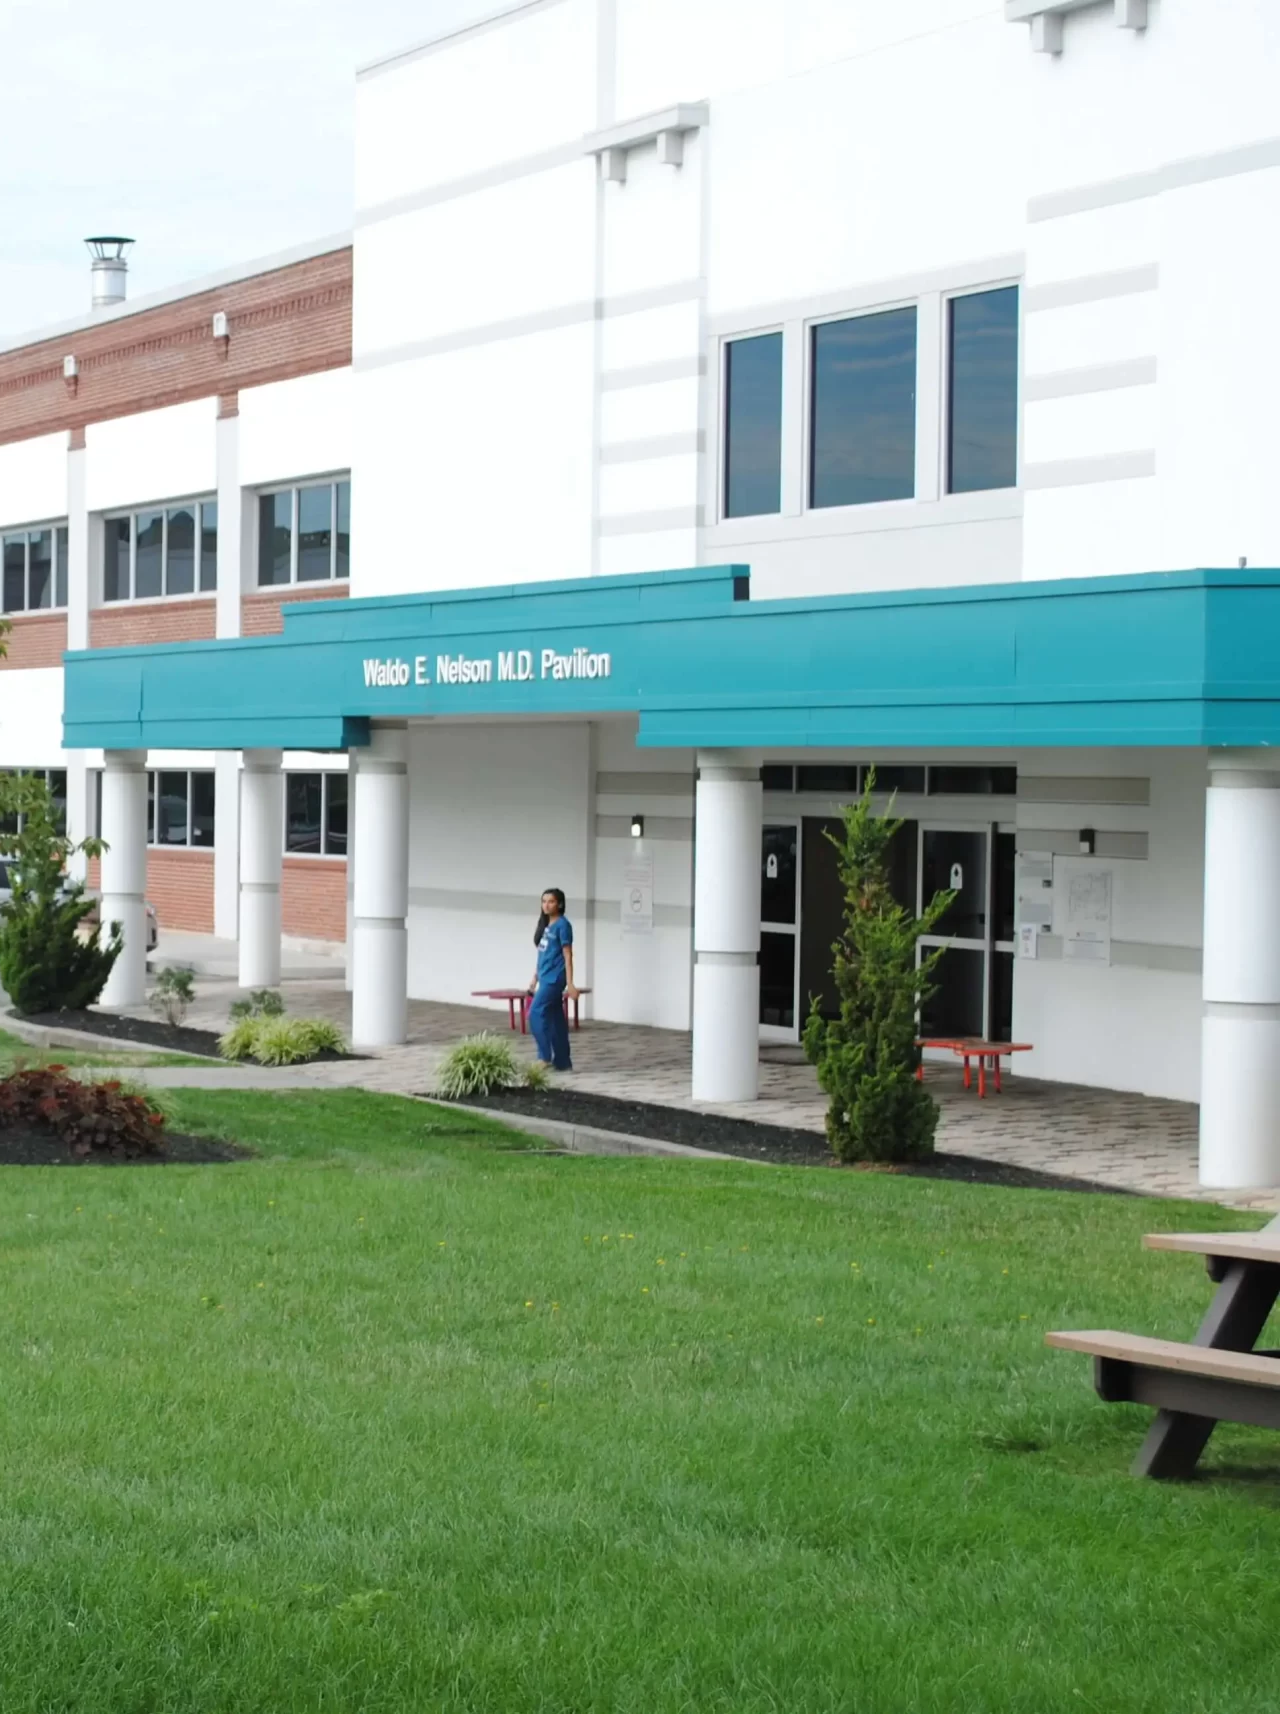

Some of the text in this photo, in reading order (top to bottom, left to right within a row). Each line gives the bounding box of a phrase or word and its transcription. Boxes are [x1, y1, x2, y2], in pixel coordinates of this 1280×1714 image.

[363, 647, 611, 687] Waldo E. Nelson M.D. Pavilion
